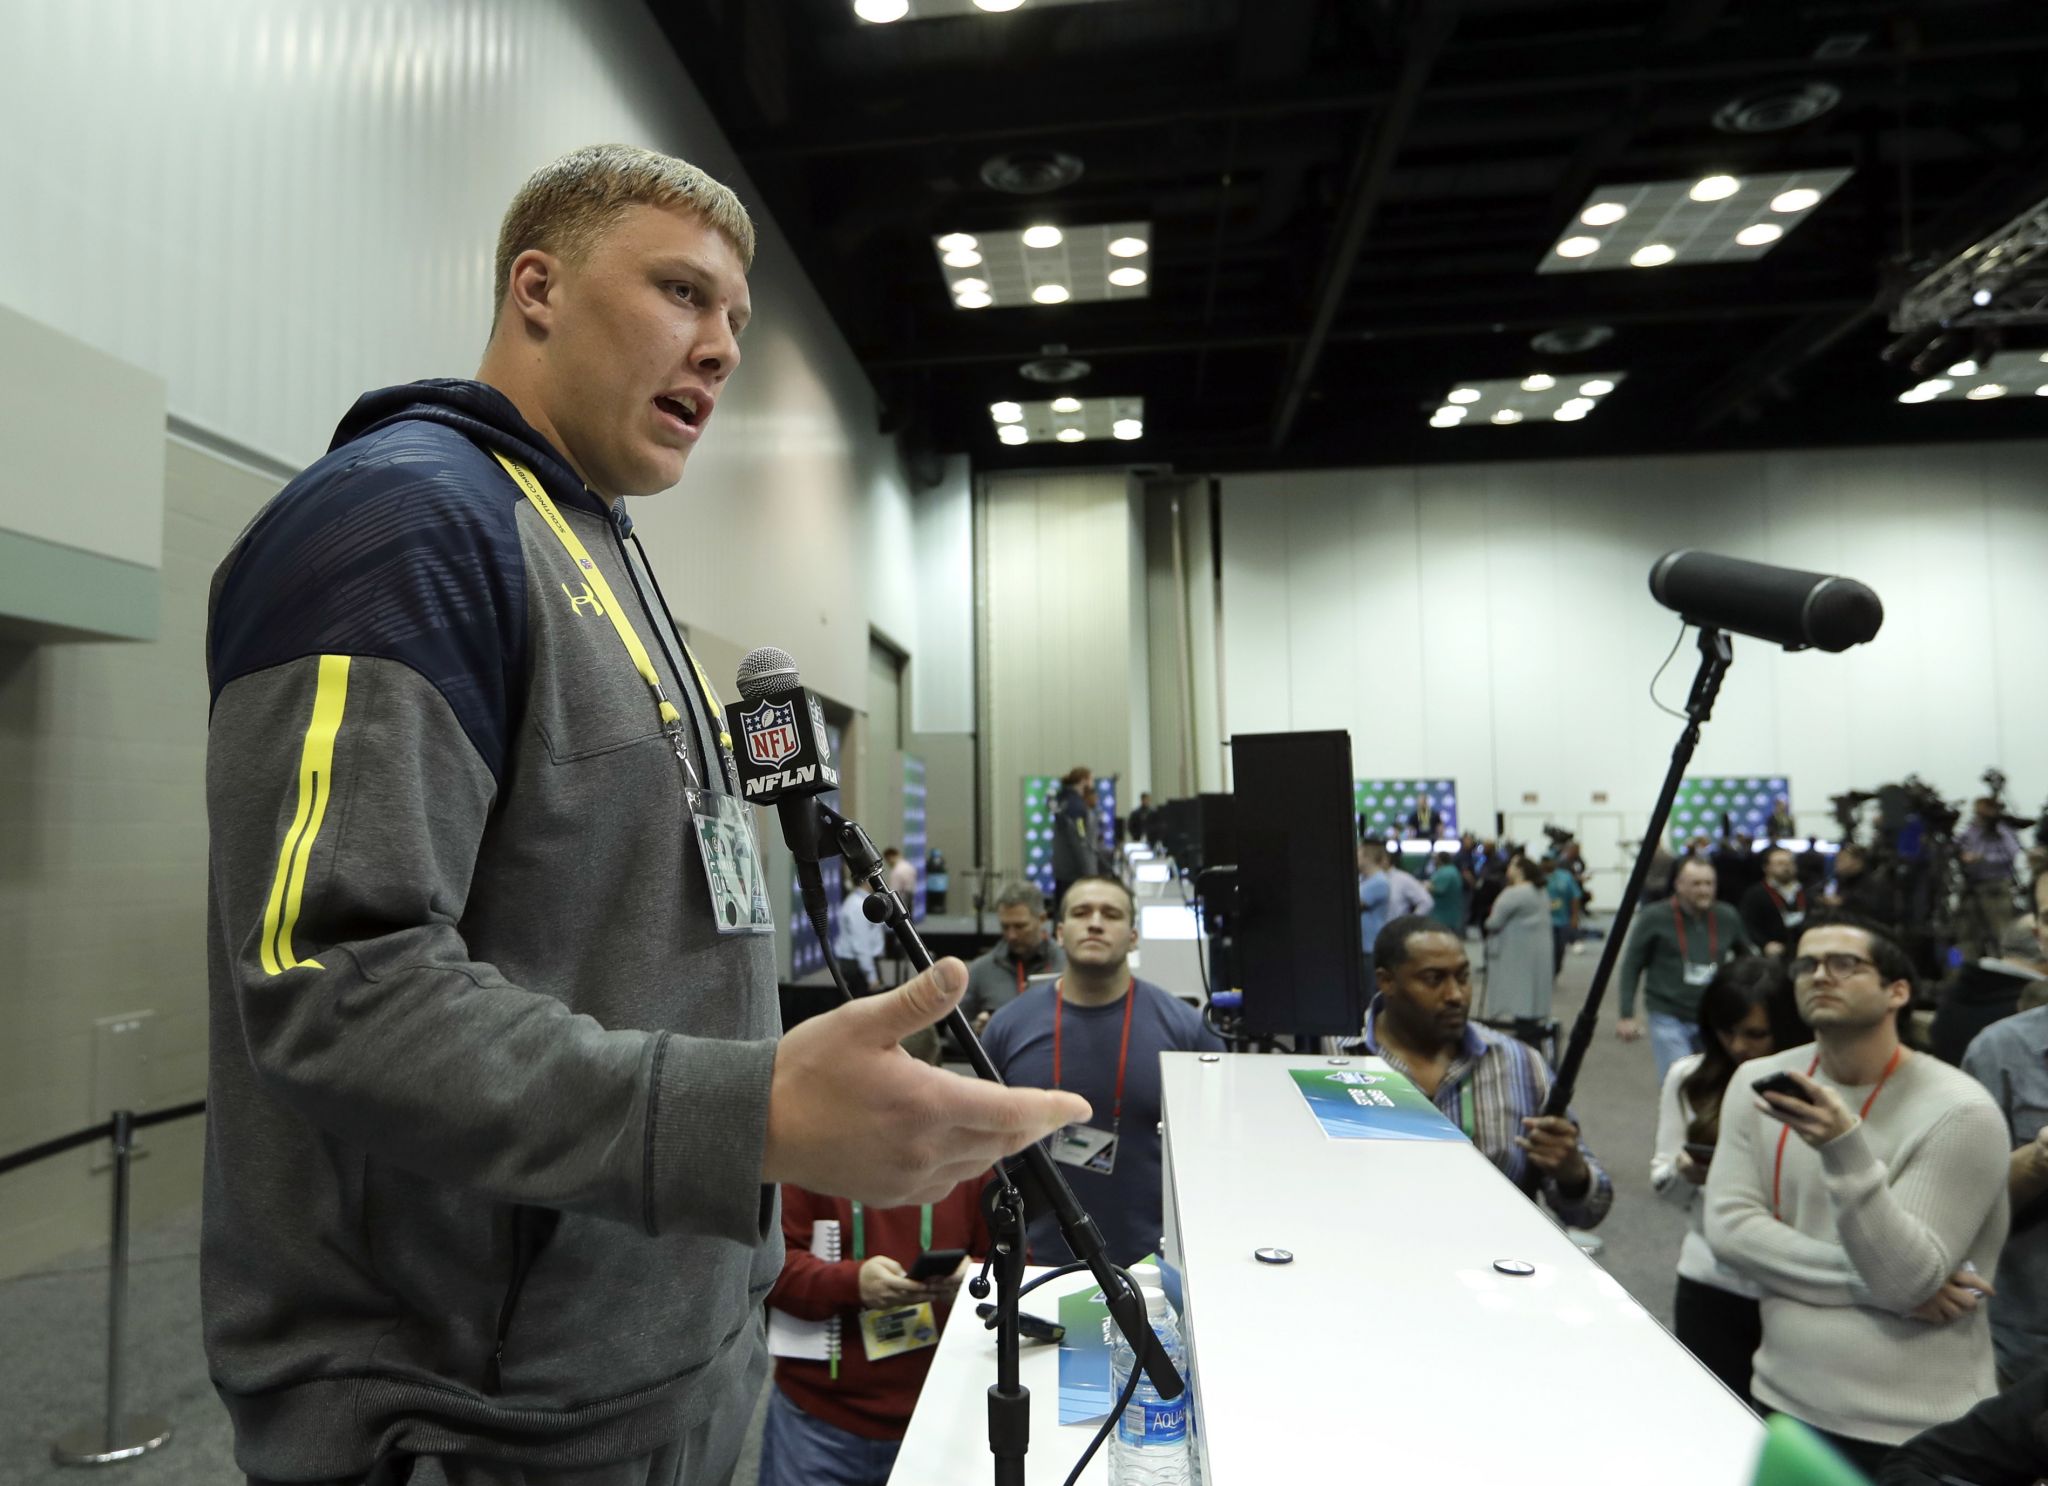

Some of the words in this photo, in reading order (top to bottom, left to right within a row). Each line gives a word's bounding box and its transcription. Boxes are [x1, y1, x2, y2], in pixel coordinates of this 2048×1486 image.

[512, 462, 537, 493] COMBIN
[535, 494, 565, 533] SCOUTING
[752, 727, 795, 759] NFL
[745, 763, 816, 796] NFLN
[1153, 1408, 1187, 1431] AQUA
